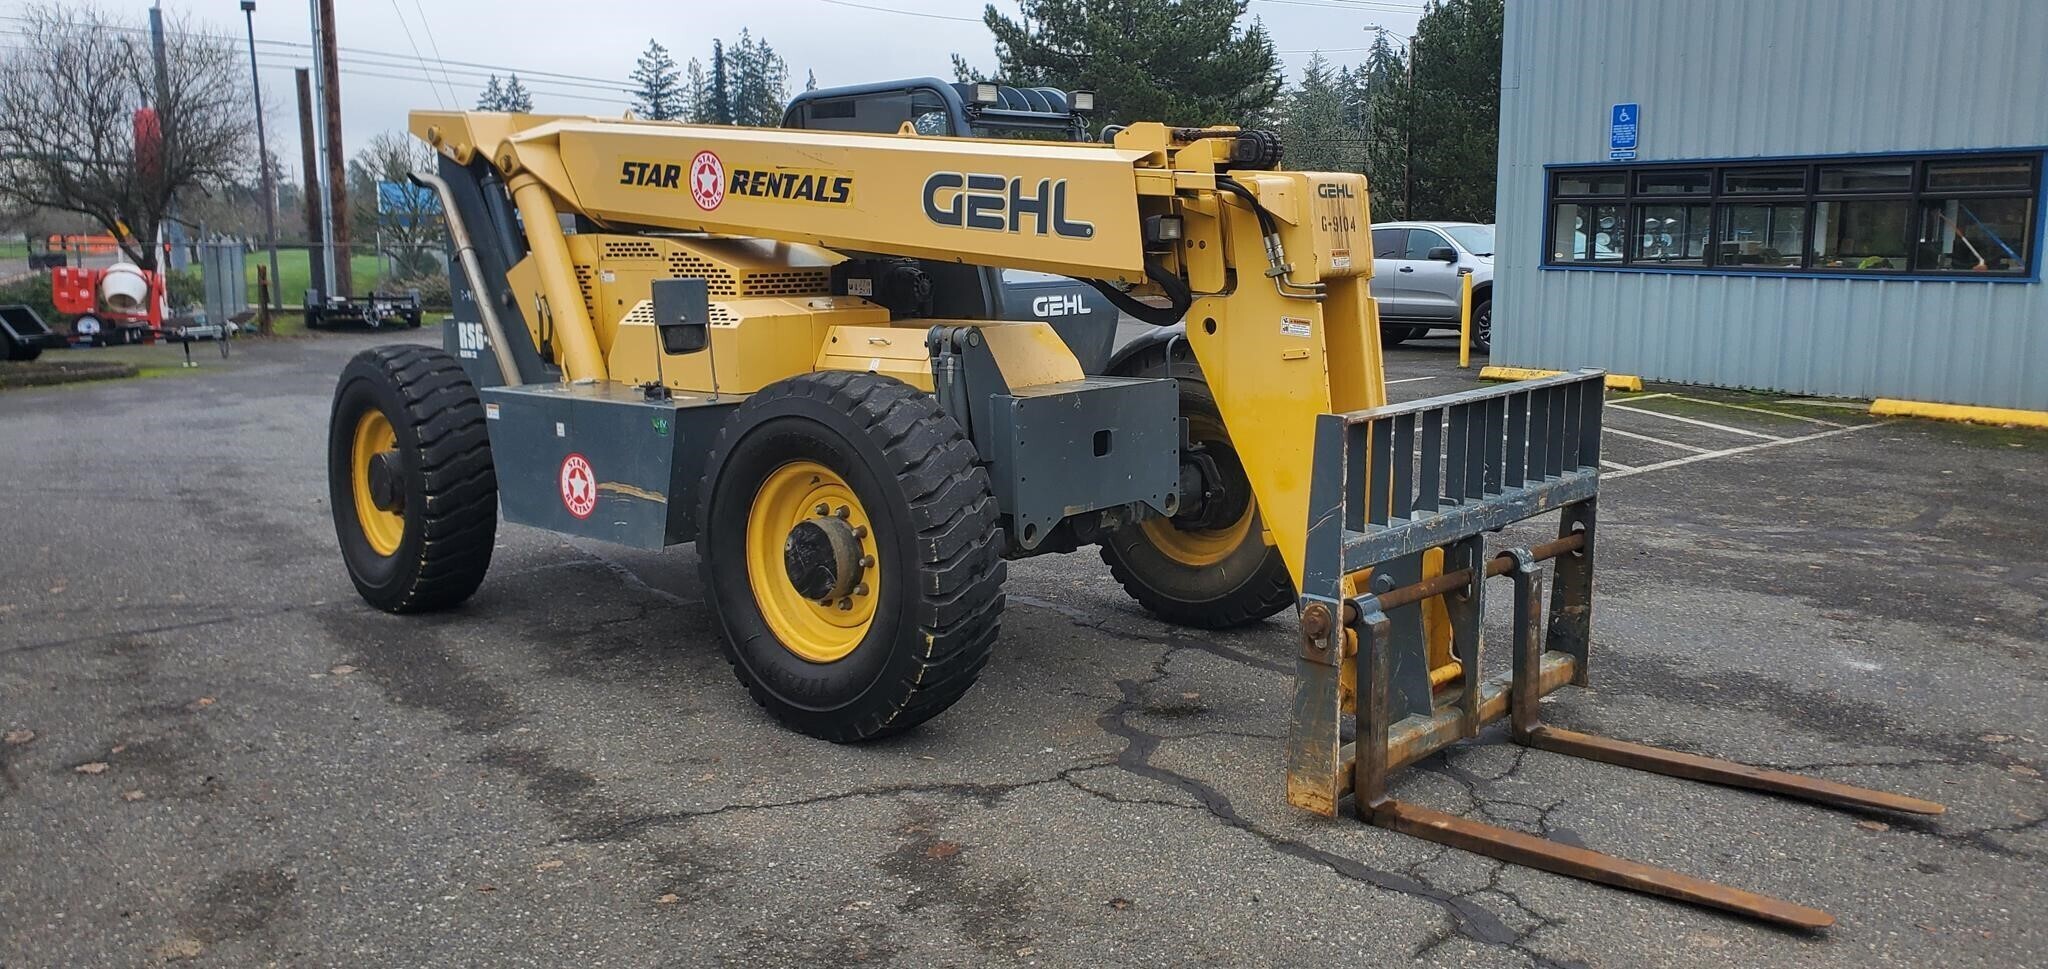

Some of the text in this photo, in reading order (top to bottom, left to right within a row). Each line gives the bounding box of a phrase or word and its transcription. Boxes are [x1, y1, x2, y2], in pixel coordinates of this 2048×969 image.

[698, 155, 717, 166] STAR
[620, 161, 852, 204] STAR RENTALS
[1318, 183, 1354, 199] GEHL
[693, 188, 722, 207] RENTALS
[922, 171, 1096, 240] GEHL
[1321, 215, 1356, 233] G-9104
[1032, 293, 1092, 317] GEHL
[458, 322, 495, 351] RS6-
[568, 459, 587, 471] STAR
[565, 493, 593, 514] RENTALS
